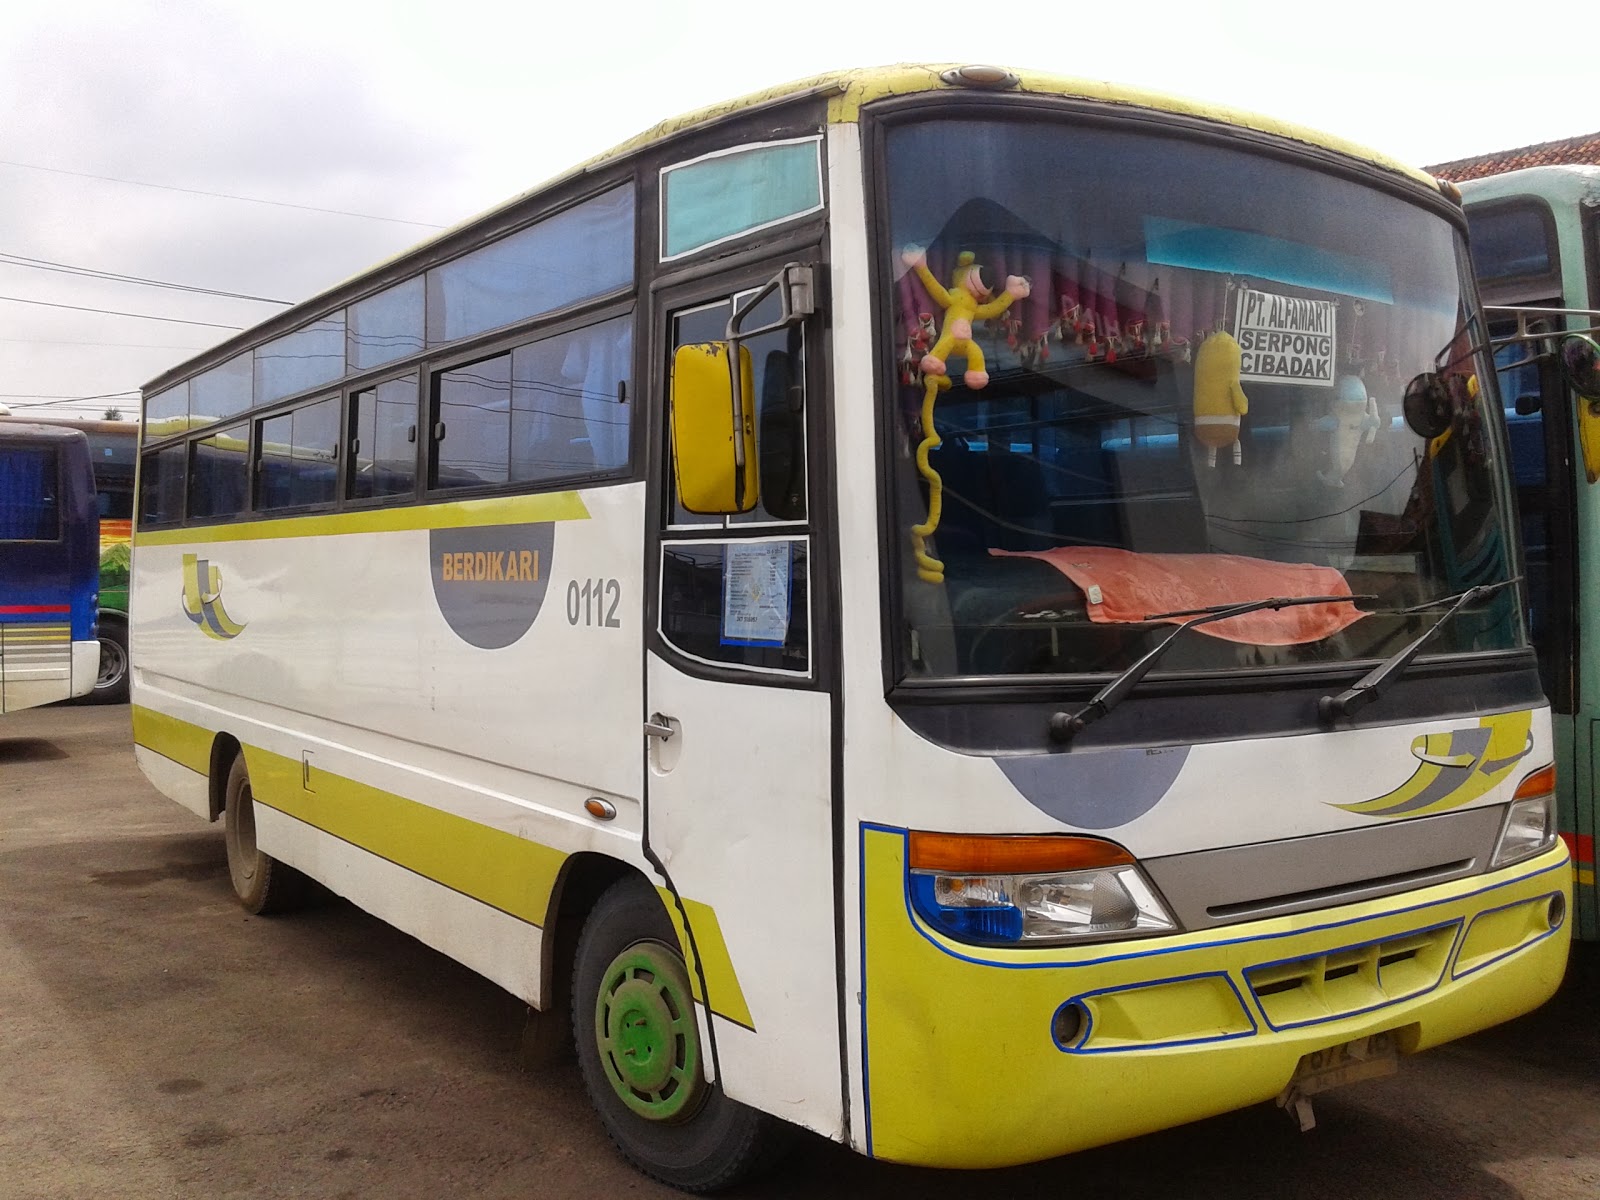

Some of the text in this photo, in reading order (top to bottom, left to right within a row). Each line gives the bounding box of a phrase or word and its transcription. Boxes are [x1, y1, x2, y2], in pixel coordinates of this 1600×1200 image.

[1268, 295, 1329, 334] ALFAMART
[1240, 331, 1330, 357] SERPONG
[1240, 352, 1329, 377] CIBADAK
[442, 550, 539, 581] BERDIKARI
[566, 578, 621, 628] 0112
